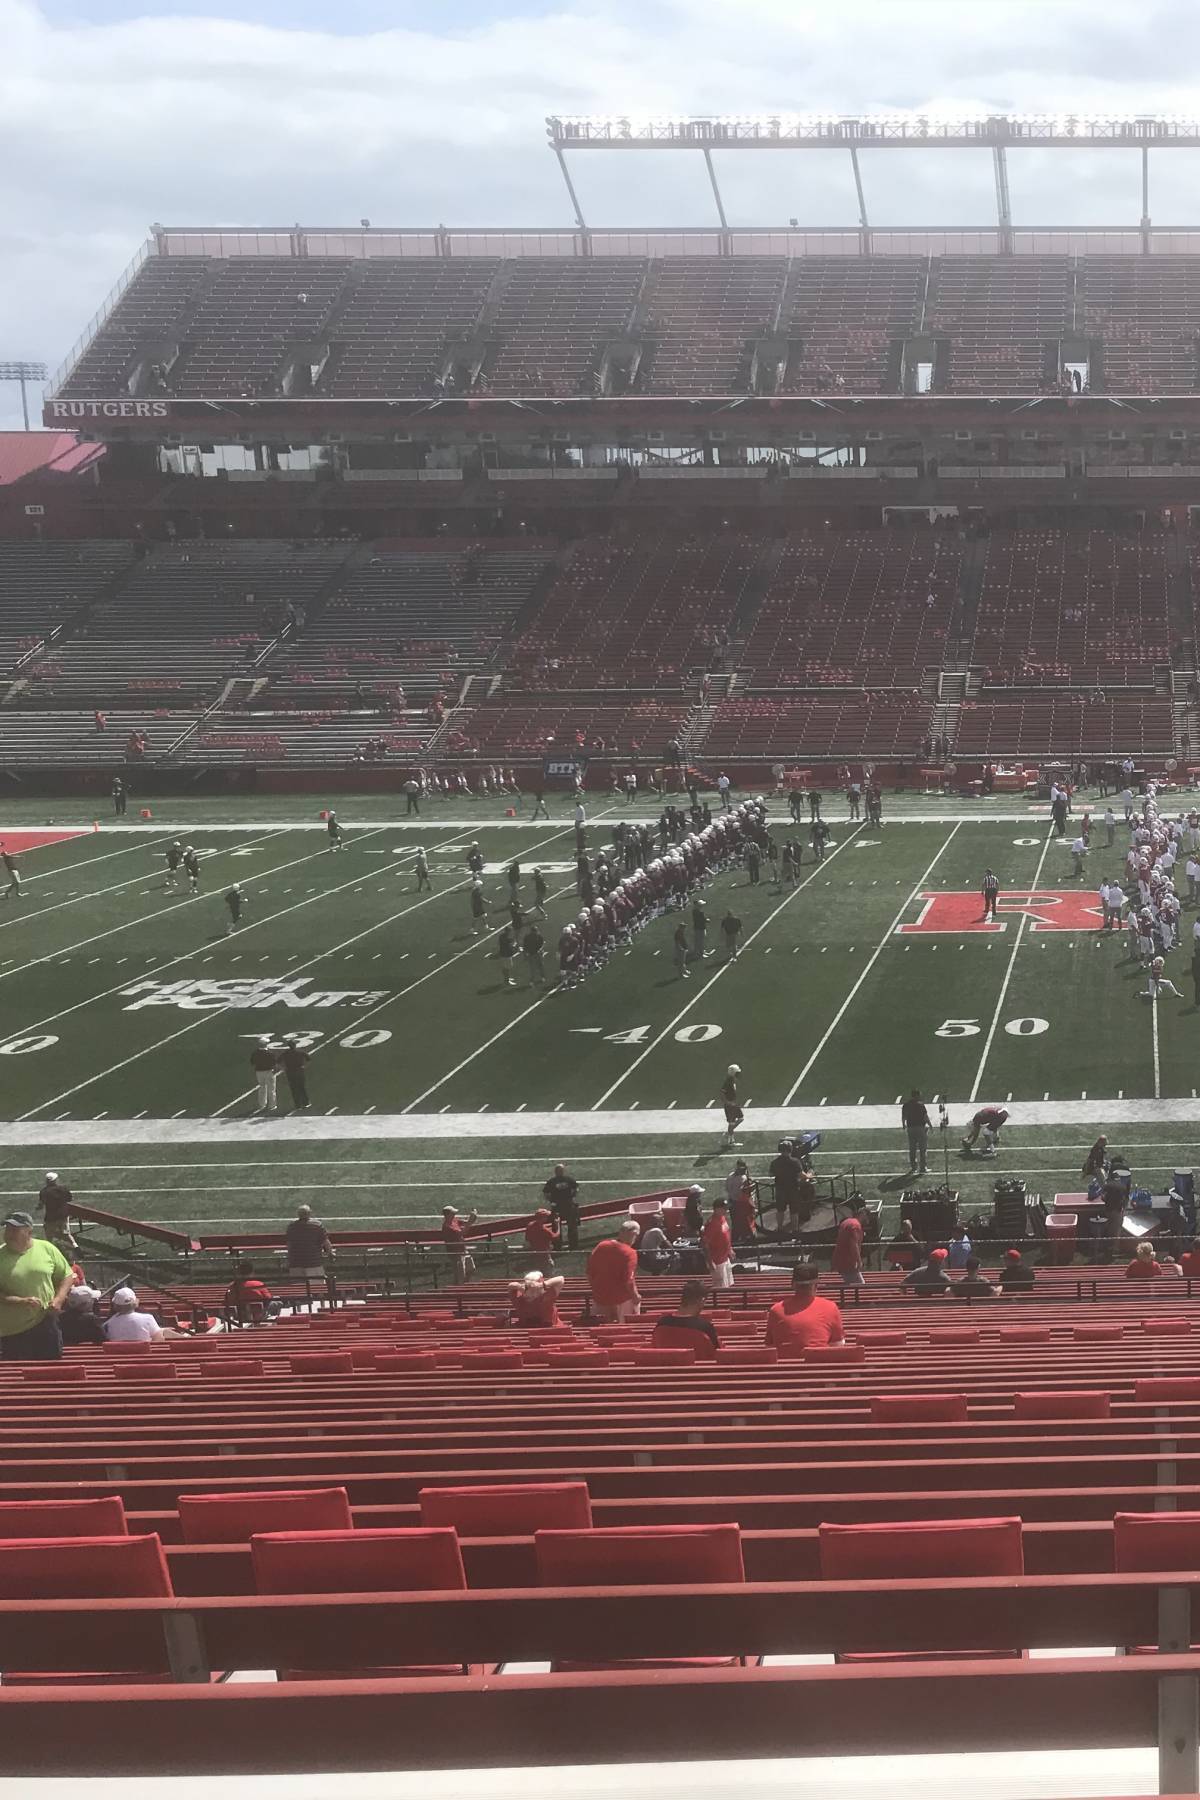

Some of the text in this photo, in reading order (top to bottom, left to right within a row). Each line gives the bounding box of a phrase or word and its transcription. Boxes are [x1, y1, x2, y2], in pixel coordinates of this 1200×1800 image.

[52, 402, 168, 417] RUTGERS
[893, 889, 1130, 934] R
[118, 977, 316, 996] HIGH
[602, 1024, 723, 1044] 40
[934, 1017, 1050, 1038] 50
